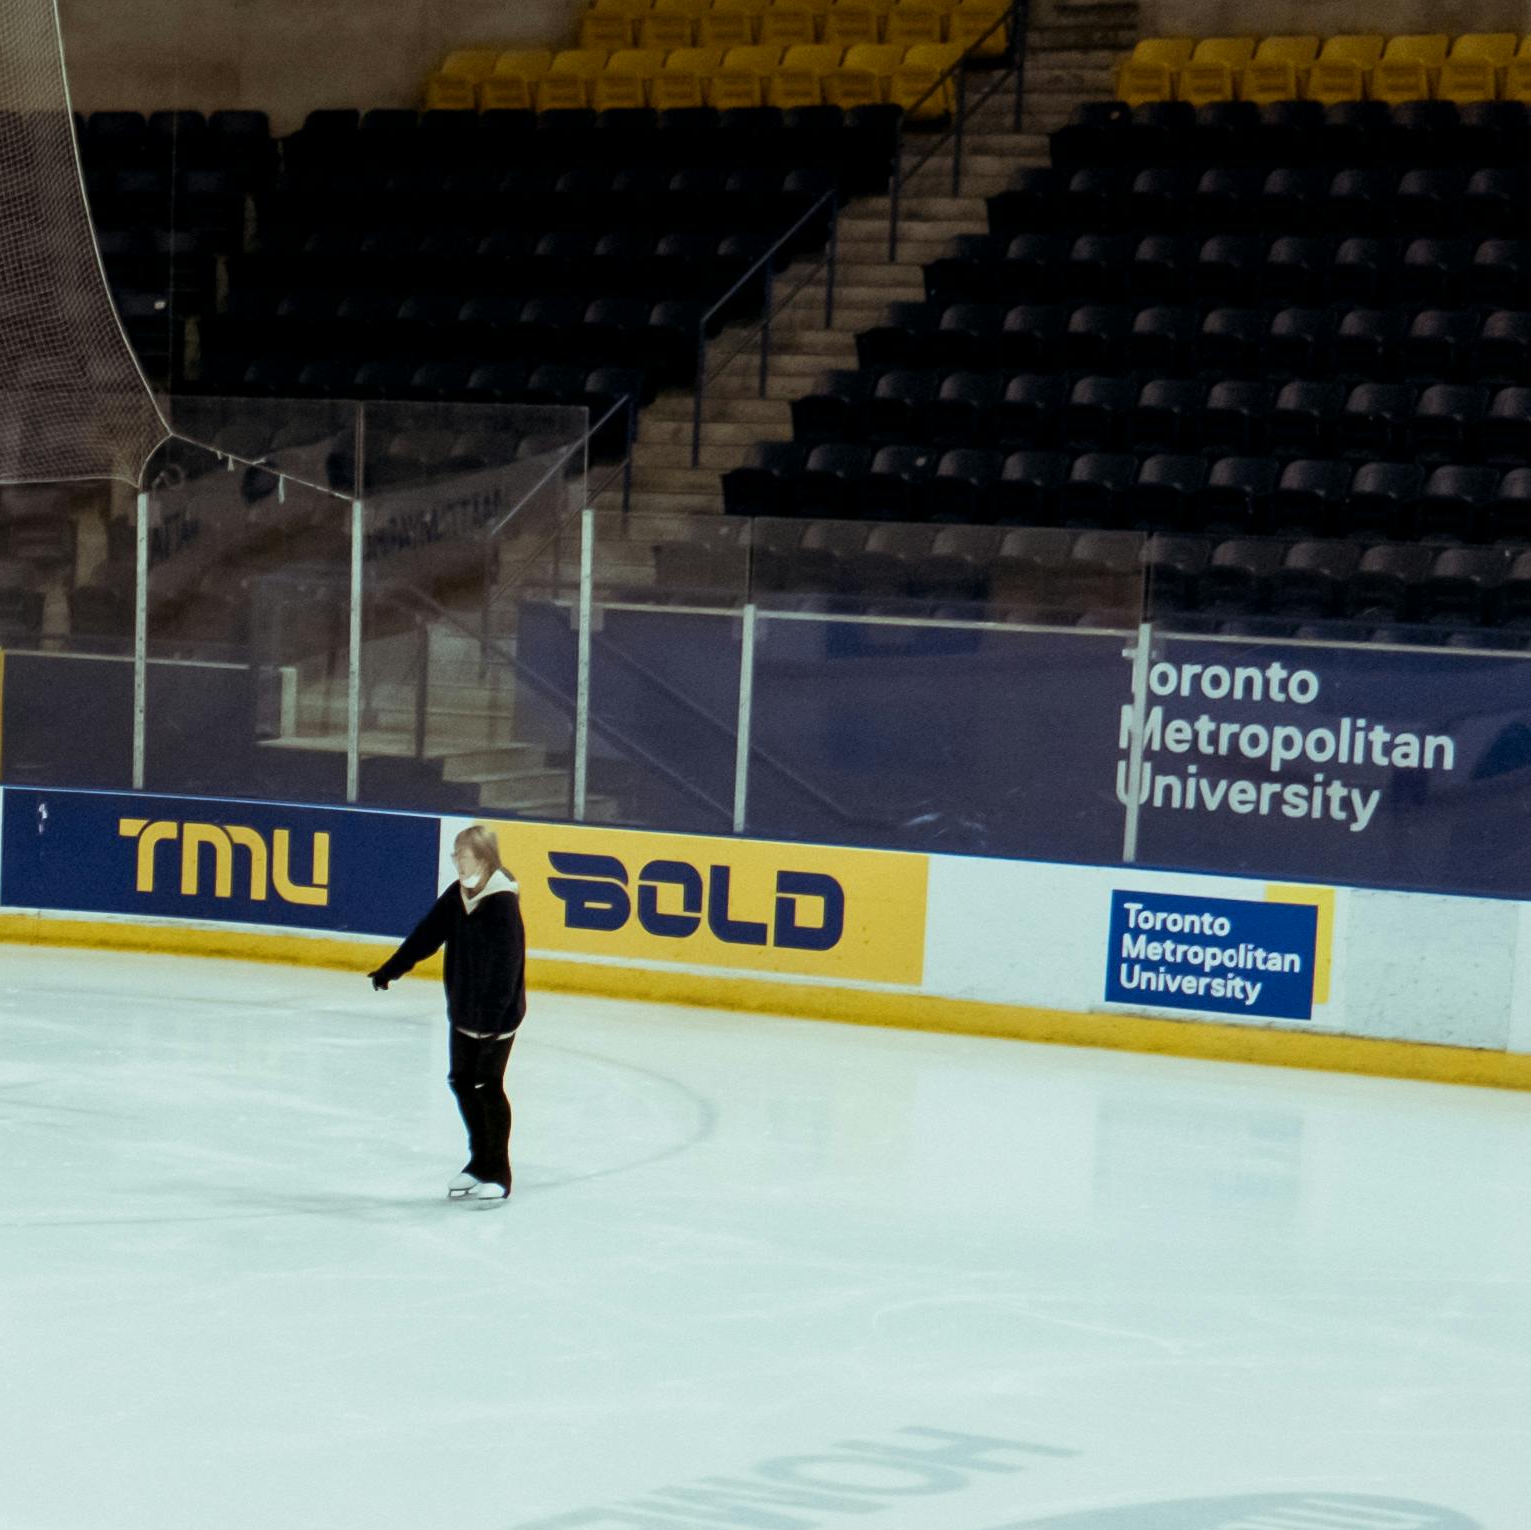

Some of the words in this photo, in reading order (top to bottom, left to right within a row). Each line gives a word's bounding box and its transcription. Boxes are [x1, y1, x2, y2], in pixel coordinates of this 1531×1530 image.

[1118, 704, 1455, 772] Metropolitan
[1115, 759, 1381, 832] University
[119, 818, 330, 906] TMU
[547, 851, 845, 951] BOLD
[1123, 902, 1231, 937] Toronto
[1120, 963, 1262, 1006] University
[1121, 932, 1301, 973] Metropolitan
